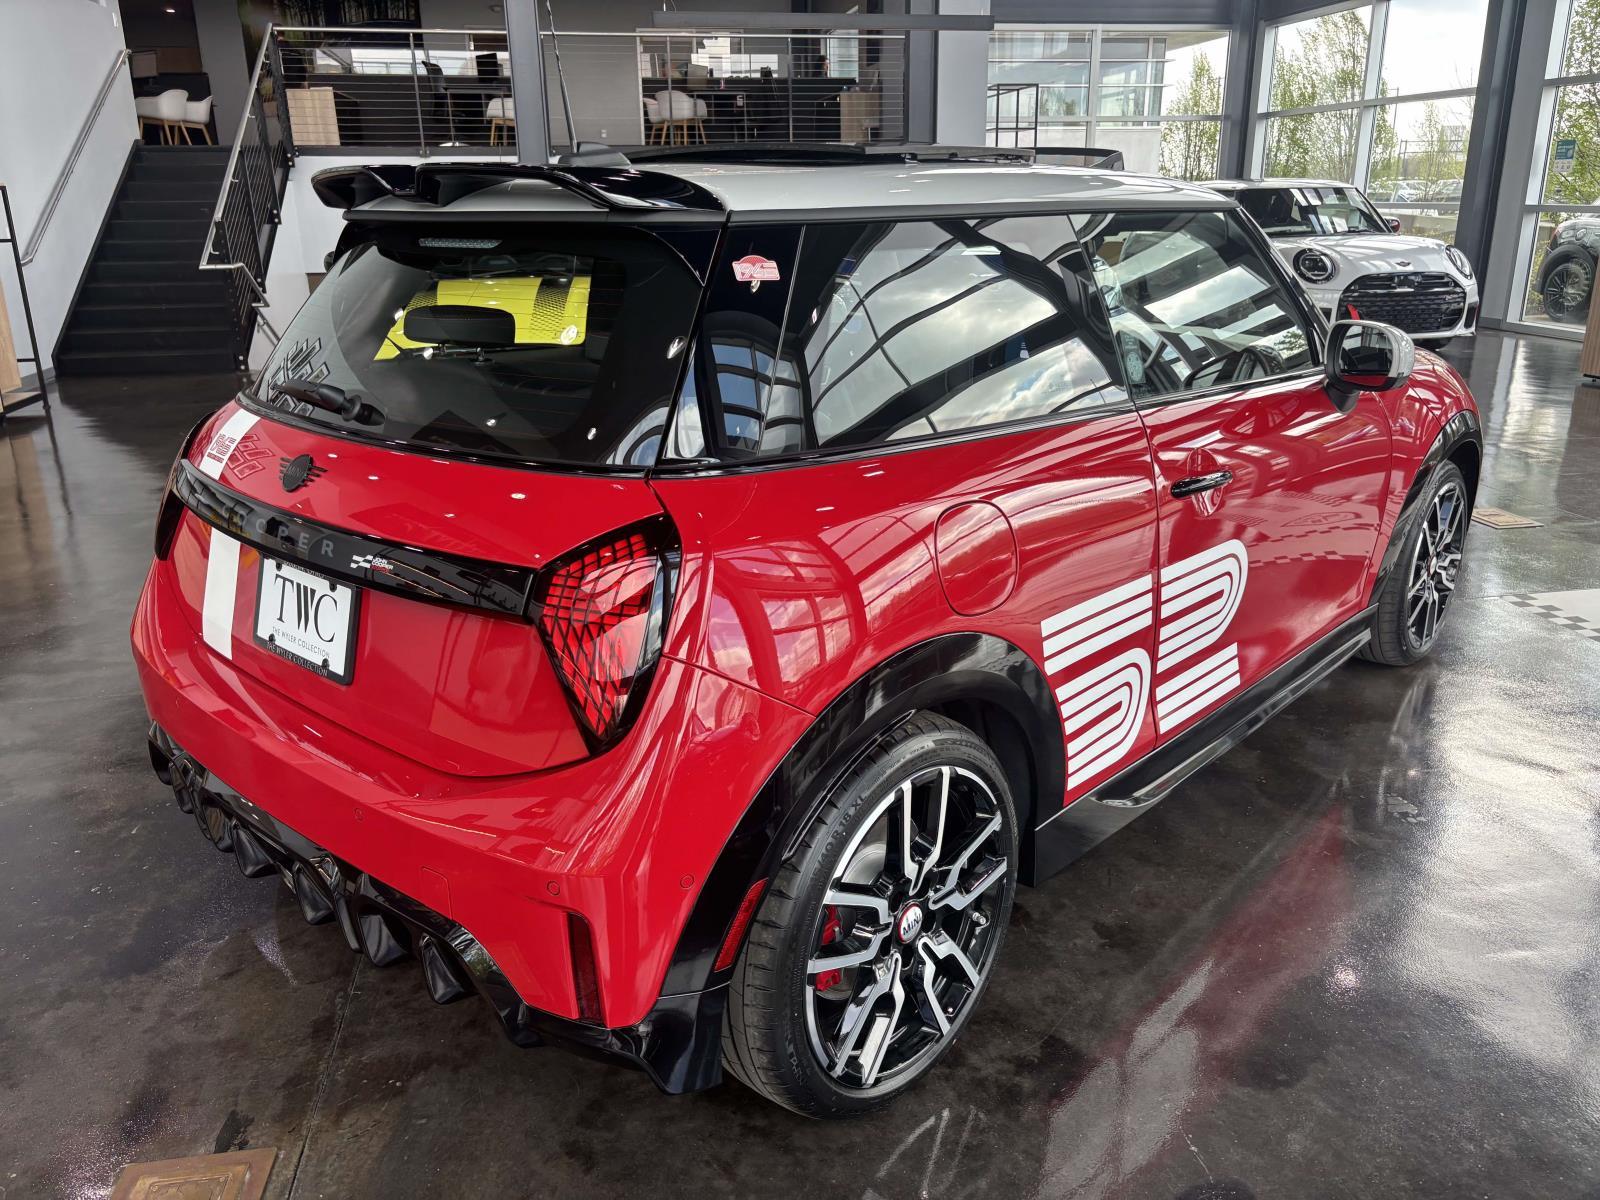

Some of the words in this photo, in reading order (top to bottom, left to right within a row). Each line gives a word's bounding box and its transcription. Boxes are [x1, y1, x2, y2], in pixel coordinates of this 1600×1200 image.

[273, 574, 338, 643] TWC
[267, 641, 276, 652] THE
[276, 646, 293, 661] WYLER
[293, 654, 328, 677] COLLECTION
[272, 626, 281, 637] THE
[281, 632, 297, 645] WYLER
[297, 638, 331, 659] COLLECTION
[902, 911, 921, 936] MINI
